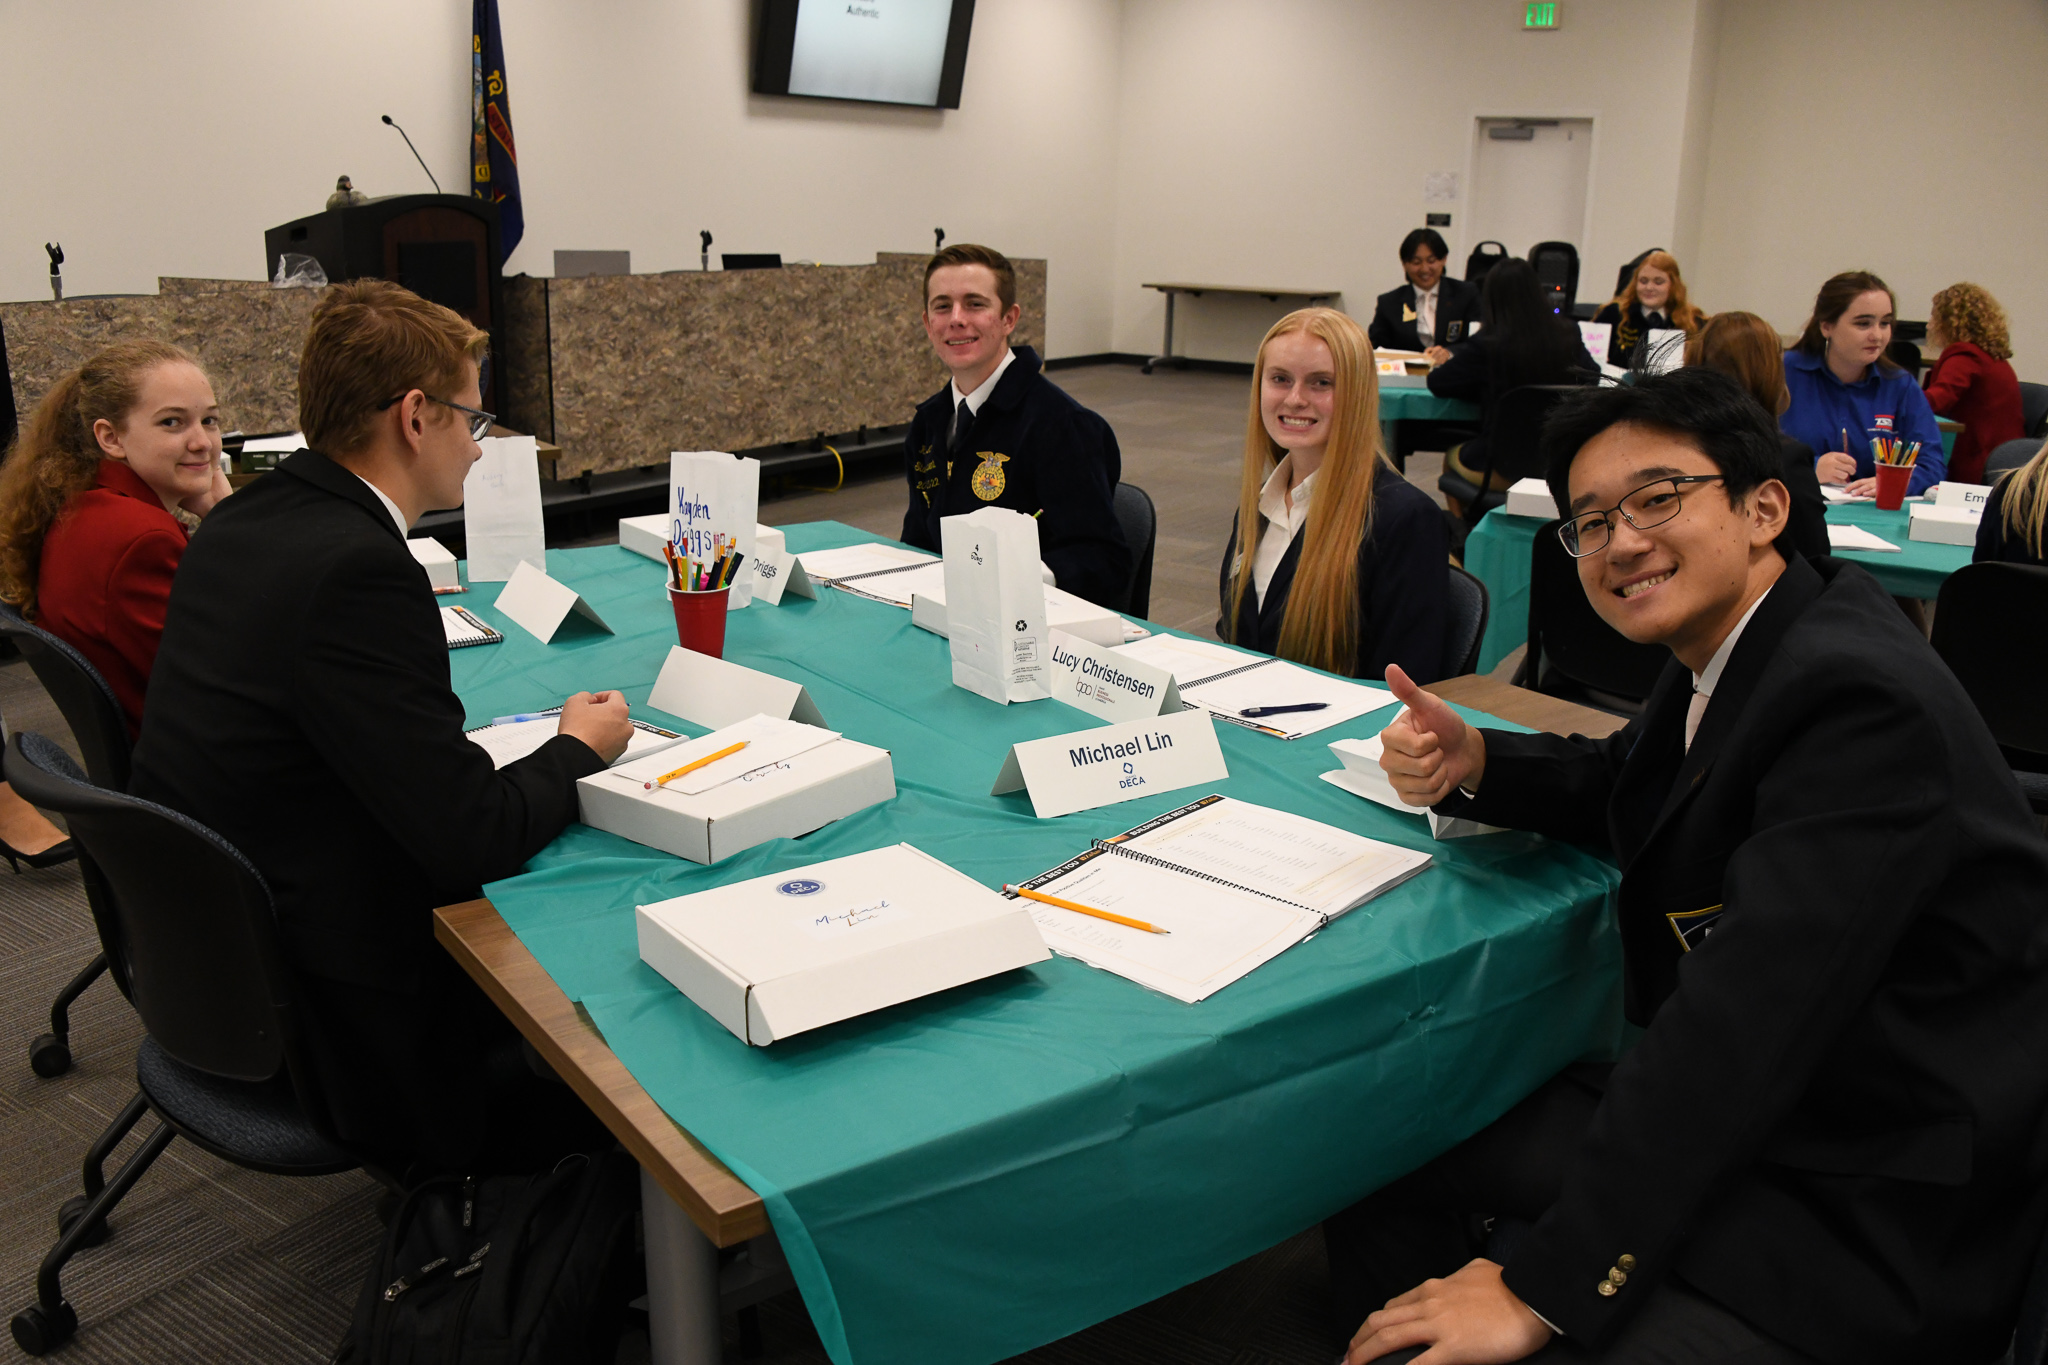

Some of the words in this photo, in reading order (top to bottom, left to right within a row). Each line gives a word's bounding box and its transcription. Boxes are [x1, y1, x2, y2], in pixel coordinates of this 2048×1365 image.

[846, 5, 879, 18] Authentic
[1526, 3, 1555, 26] EXIT
[1964, 492, 1988, 503] Em
[1052, 645, 1080, 672] Lucy
[1082, 657, 1154, 699] Christensen
[1069, 736, 1142, 767] Michael
[1144, 732, 1173, 751] Lin
[1119, 776, 1146, 789] DECA
[1130, 821, 1160, 836] BUILDING
[1158, 815, 1173, 823] THE
[1171, 809, 1188, 818] BEST
[1186, 803, 1200, 811] YOU
[1033, 876, 1048, 887] THE
[1046, 869, 1065, 880] BEST
[1063, 860, 1080, 871] YOU
[790, 885, 818, 894] DECA
